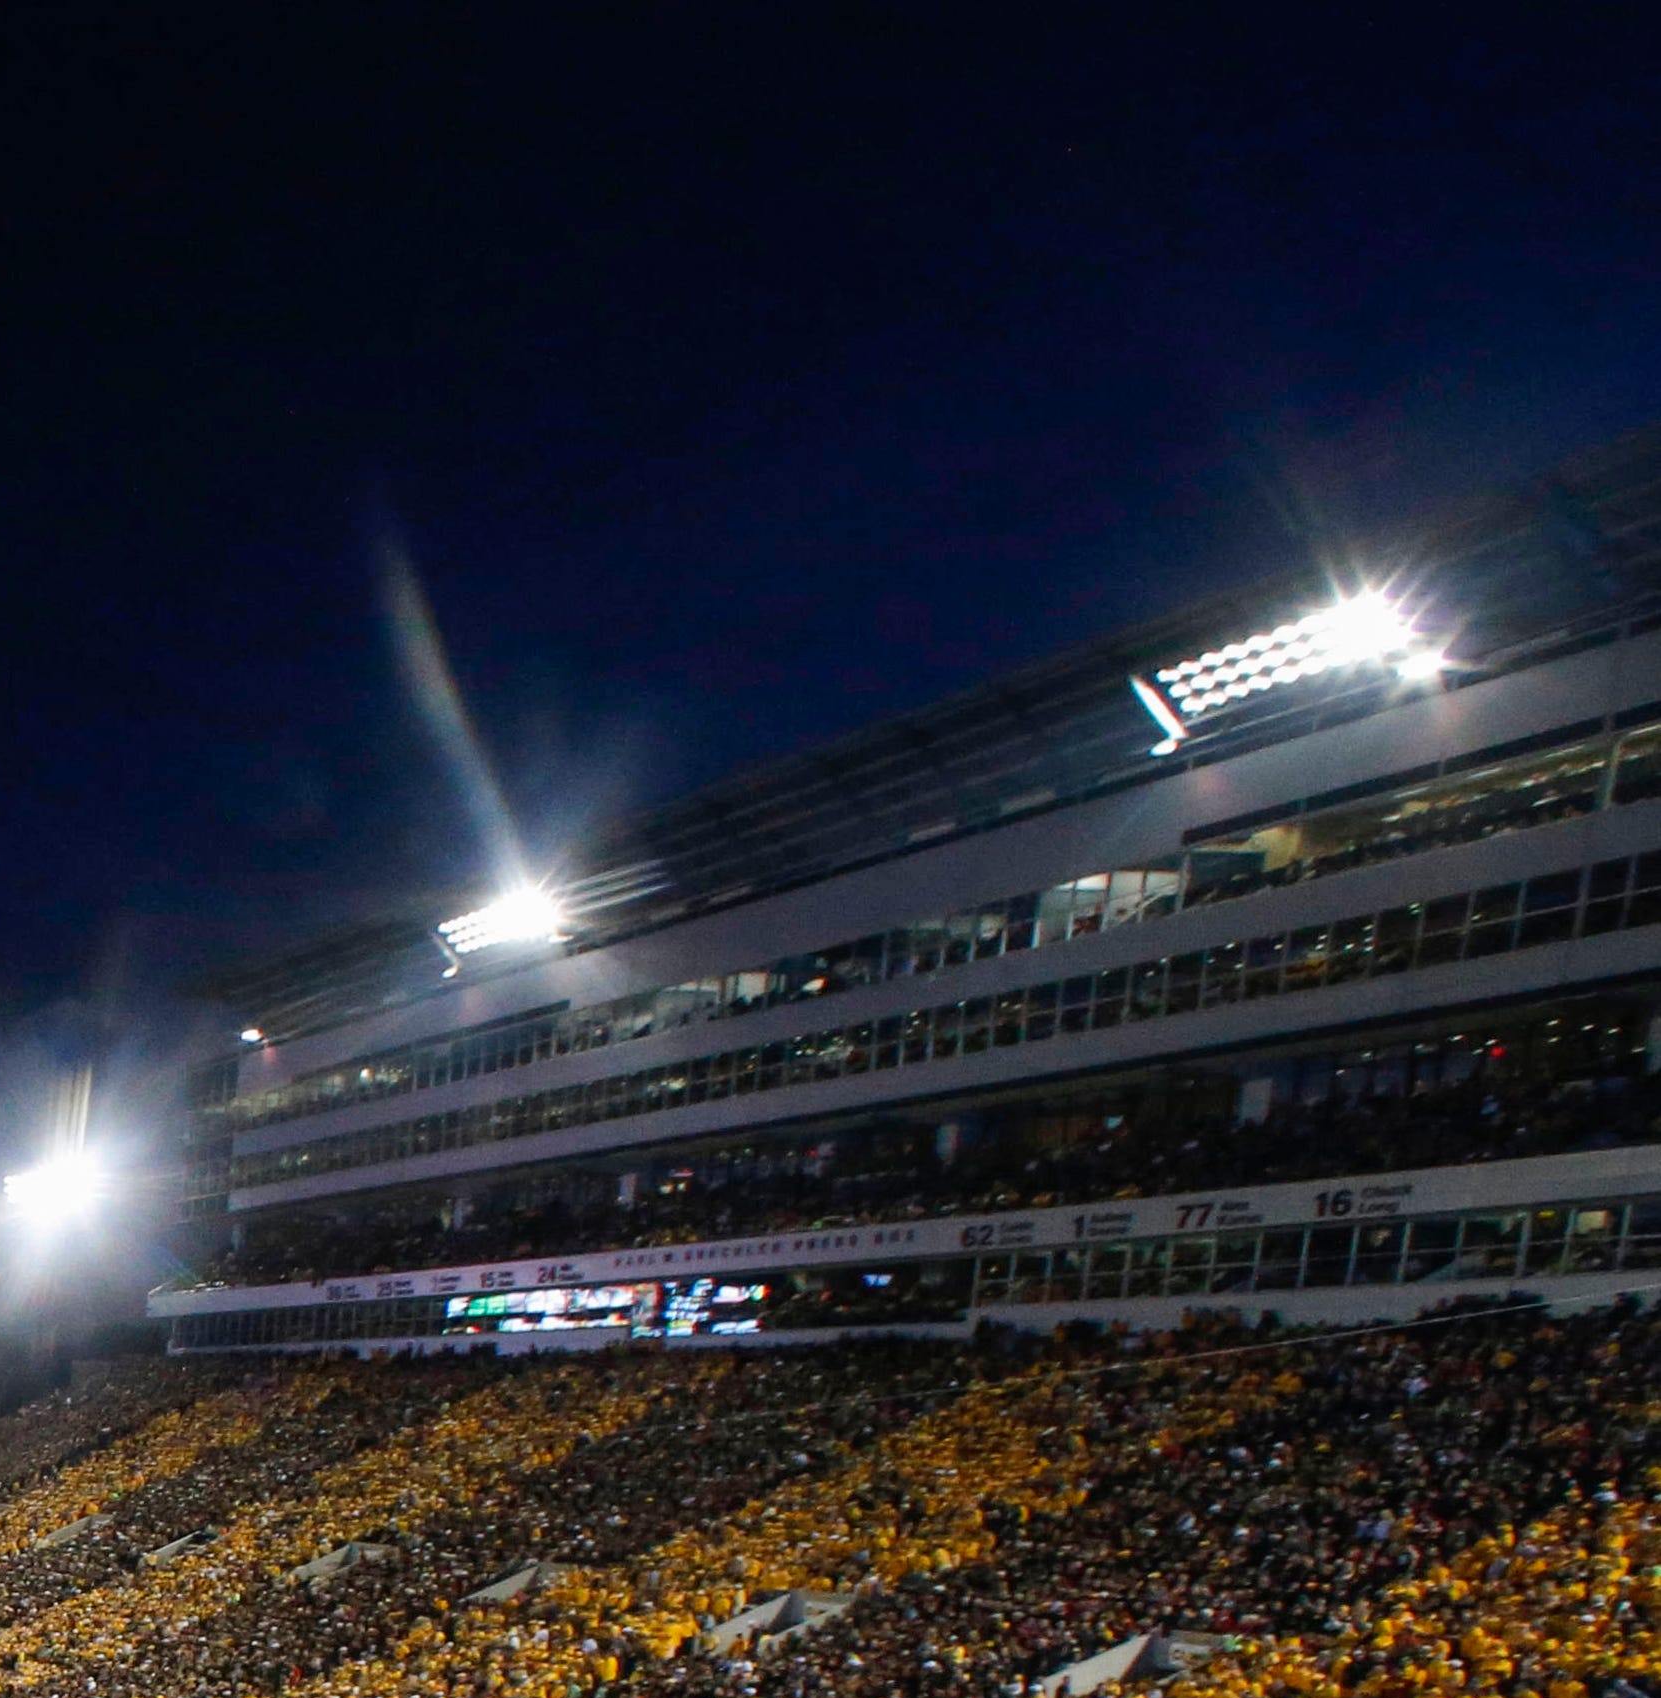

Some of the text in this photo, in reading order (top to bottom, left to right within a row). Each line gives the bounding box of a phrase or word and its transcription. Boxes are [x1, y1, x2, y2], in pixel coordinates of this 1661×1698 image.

[1315, 1190, 1353, 1217] 16
[1176, 1203, 1215, 1229] 77
[959, 1225, 995, 1247] 62
[537, 1266, 557, 1285] 24
